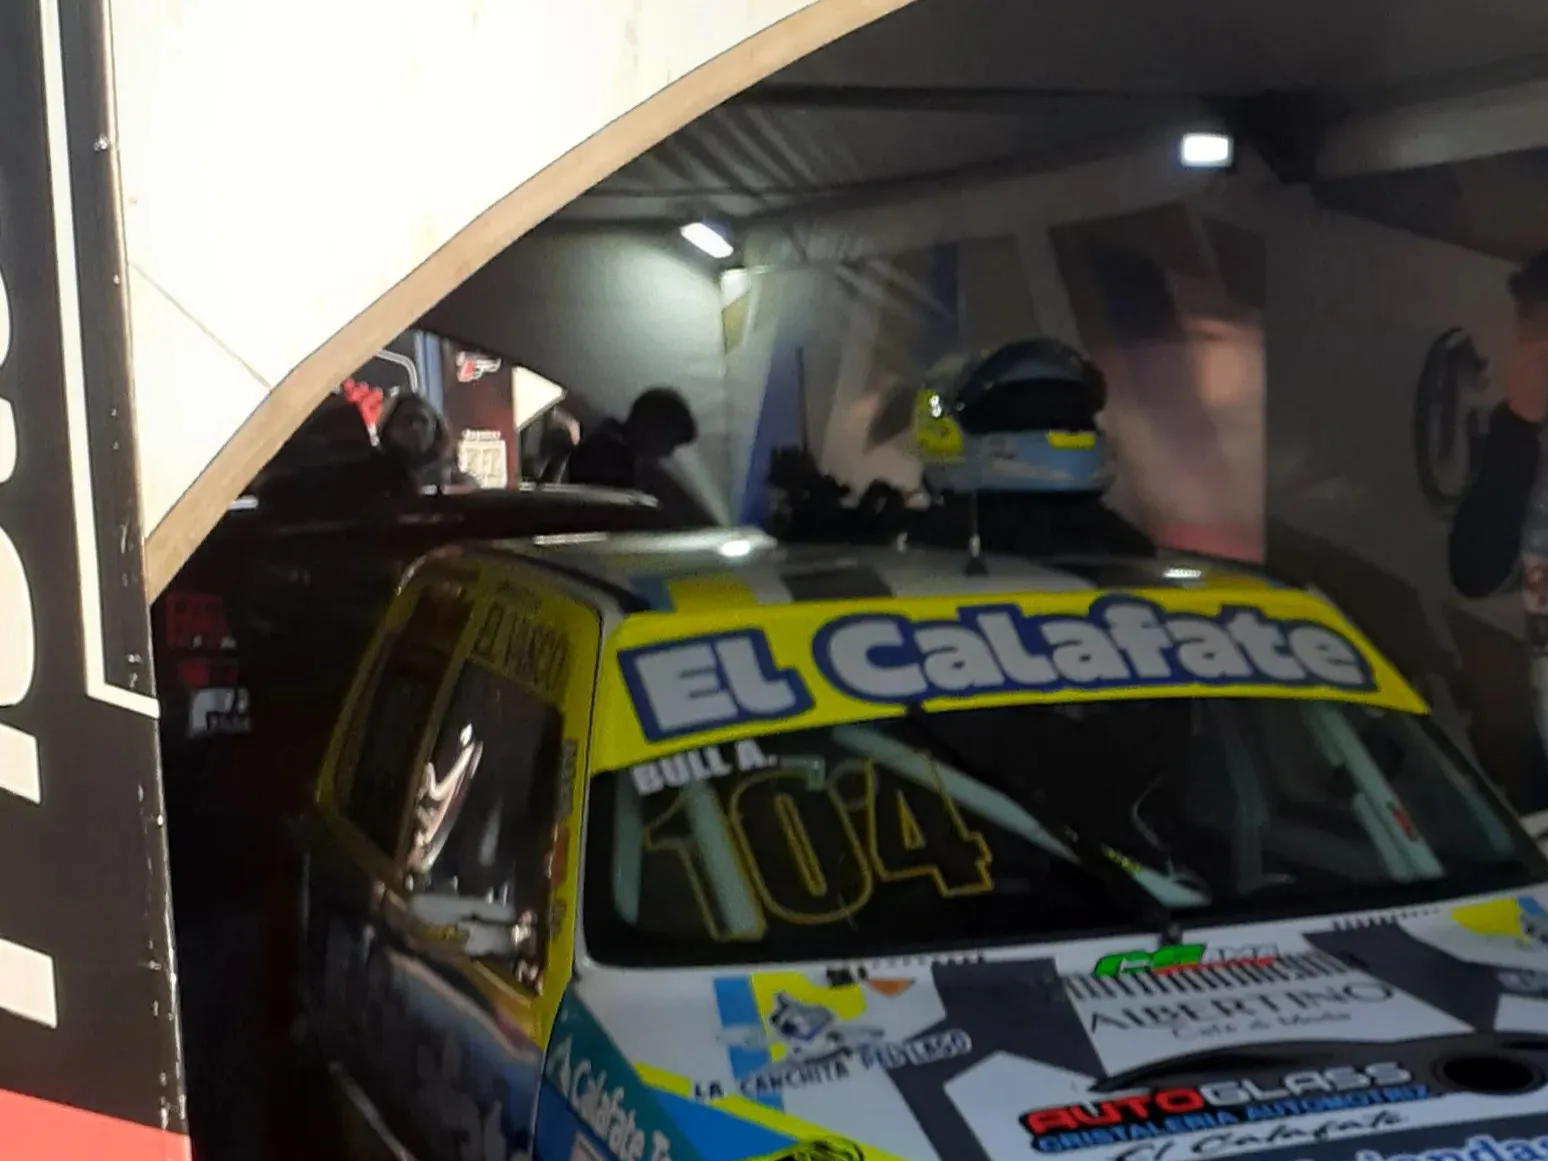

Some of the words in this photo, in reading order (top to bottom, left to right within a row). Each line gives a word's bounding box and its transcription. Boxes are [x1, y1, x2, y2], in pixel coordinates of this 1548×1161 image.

[631, 744, 734, 796] BULL
[643, 749, 994, 942] 104
[694, 1080, 724, 1100] LA
[738, 1060, 850, 1096] CANCHITA
[1025, 1061, 1412, 1134] AUTOGLASS
